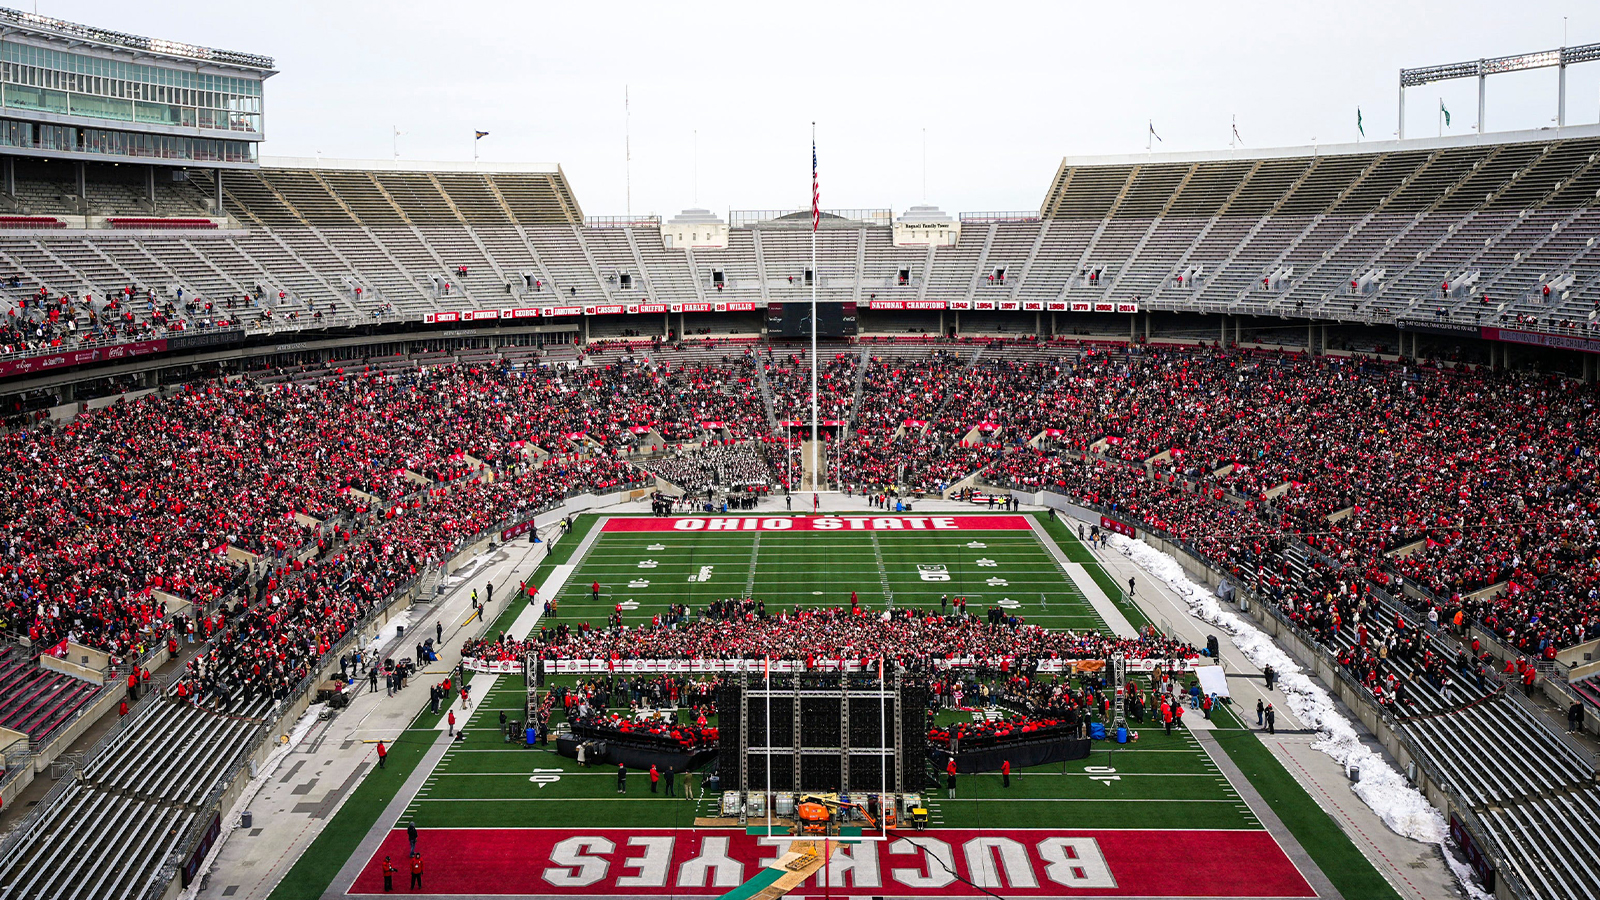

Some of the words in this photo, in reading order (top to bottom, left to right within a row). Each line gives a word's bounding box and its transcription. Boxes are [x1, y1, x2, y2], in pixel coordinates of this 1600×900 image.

[684, 303, 708, 311] HARLEY
[515, 309, 537, 317] GEORGE
[674, 518, 793, 530] OHIO
[813, 517, 959, 530] STATE
